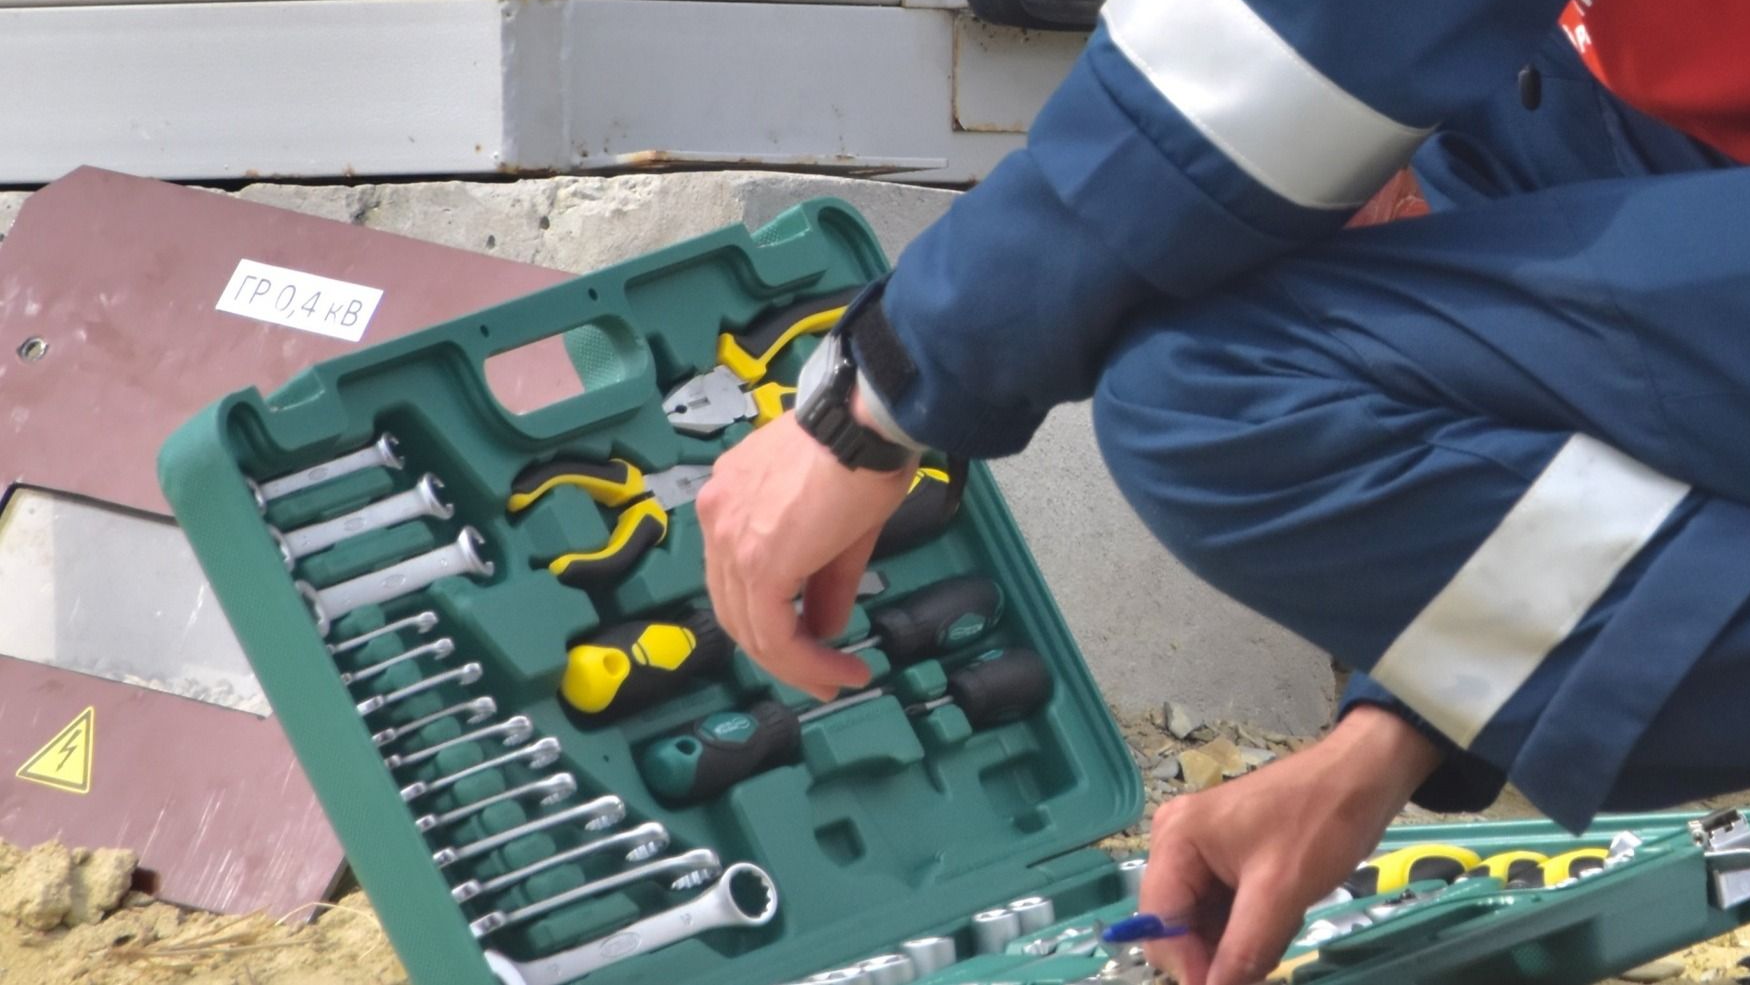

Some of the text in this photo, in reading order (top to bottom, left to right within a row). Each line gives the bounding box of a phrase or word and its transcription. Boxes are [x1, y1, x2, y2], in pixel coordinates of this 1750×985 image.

[234, 275, 363, 327] ГР 0,4 кВ
